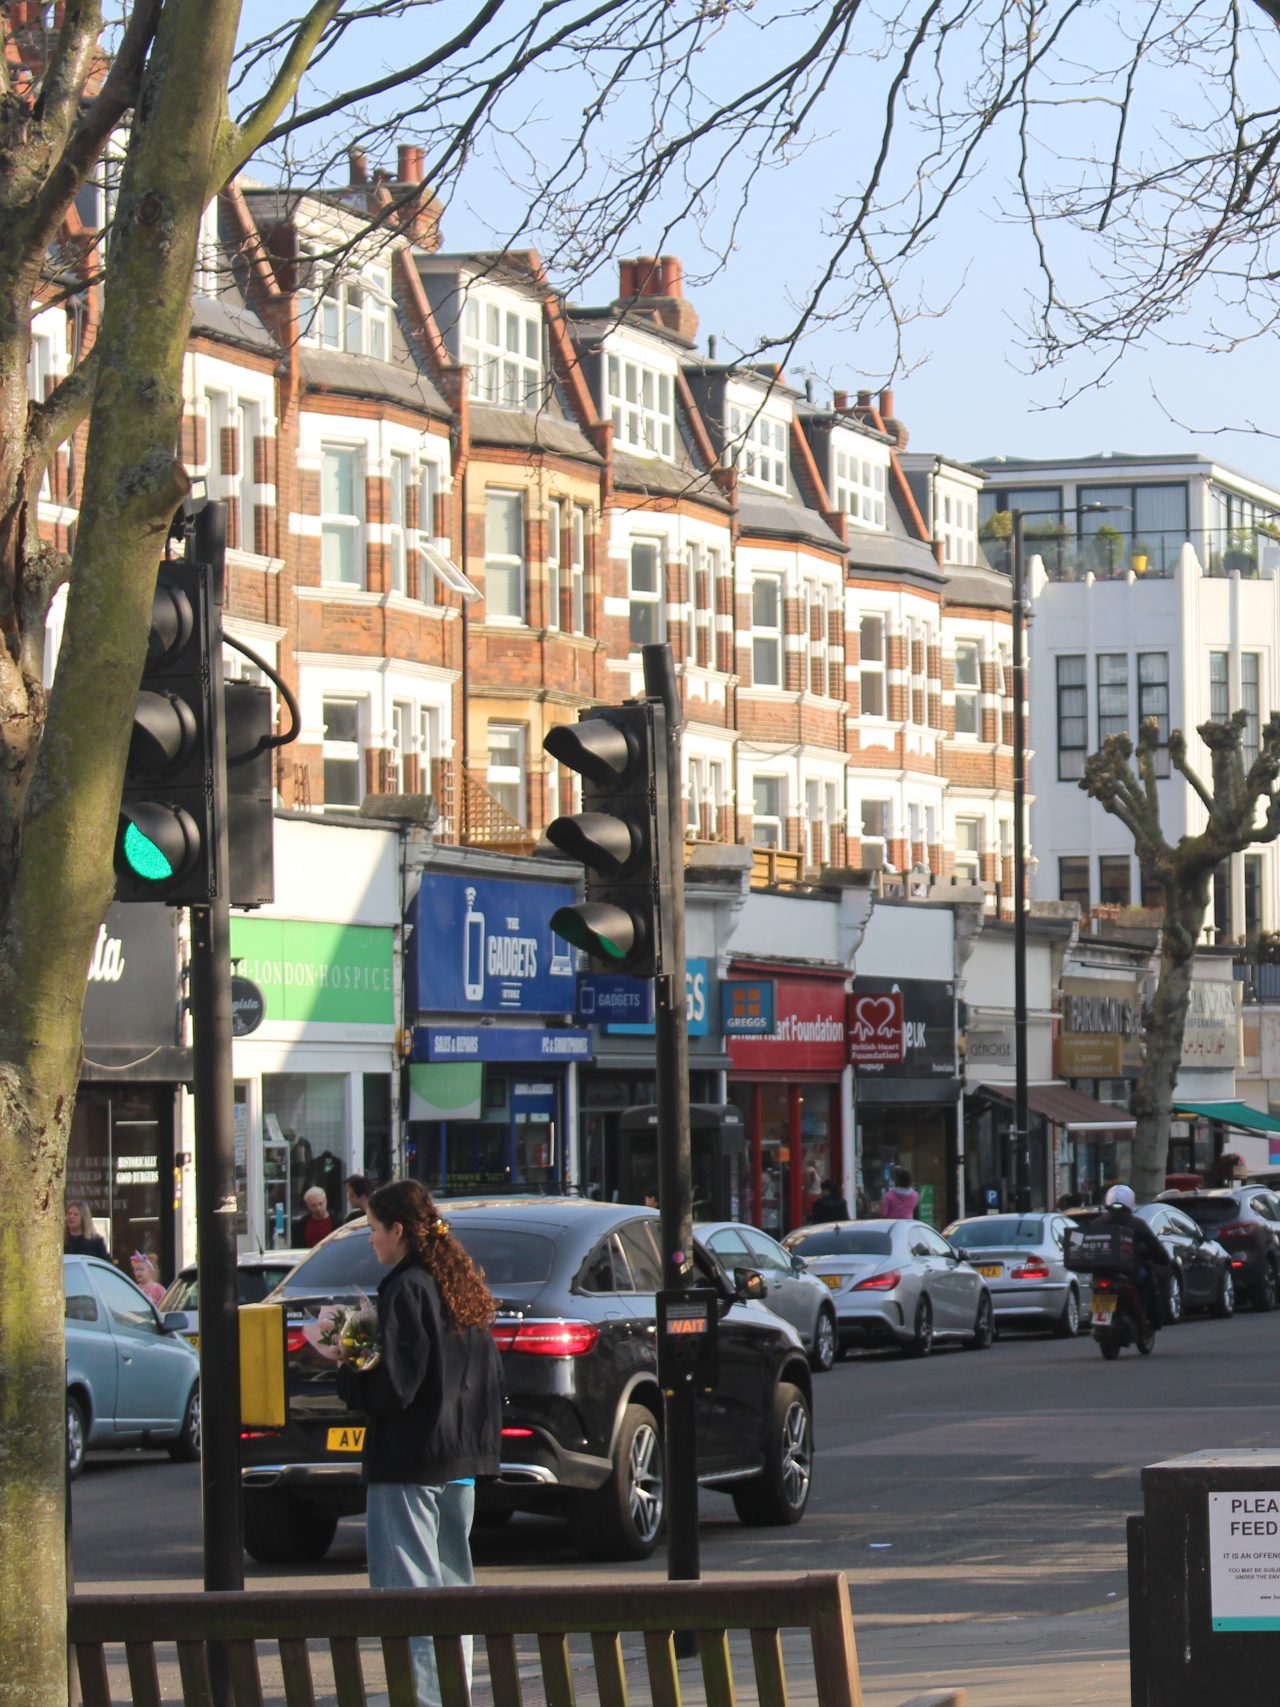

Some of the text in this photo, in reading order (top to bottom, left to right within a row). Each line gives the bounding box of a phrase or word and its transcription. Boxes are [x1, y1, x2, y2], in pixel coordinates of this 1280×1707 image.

[487, 934, 538, 979] GADGETS
[319, 964, 391, 992] HOSPICE
[598, 993, 641, 1007] GADGETS
[727, 1017, 768, 1028] GREGGS
[791, 1013, 844, 1042] Foundation
[878, 1043, 899, 1051] Heart
[852, 1052, 900, 1060] Foundation
[671, 1319, 705, 1333] WAIT
[340, 1430, 362, 1447] AV
[1230, 1521, 1278, 1536] FEED
